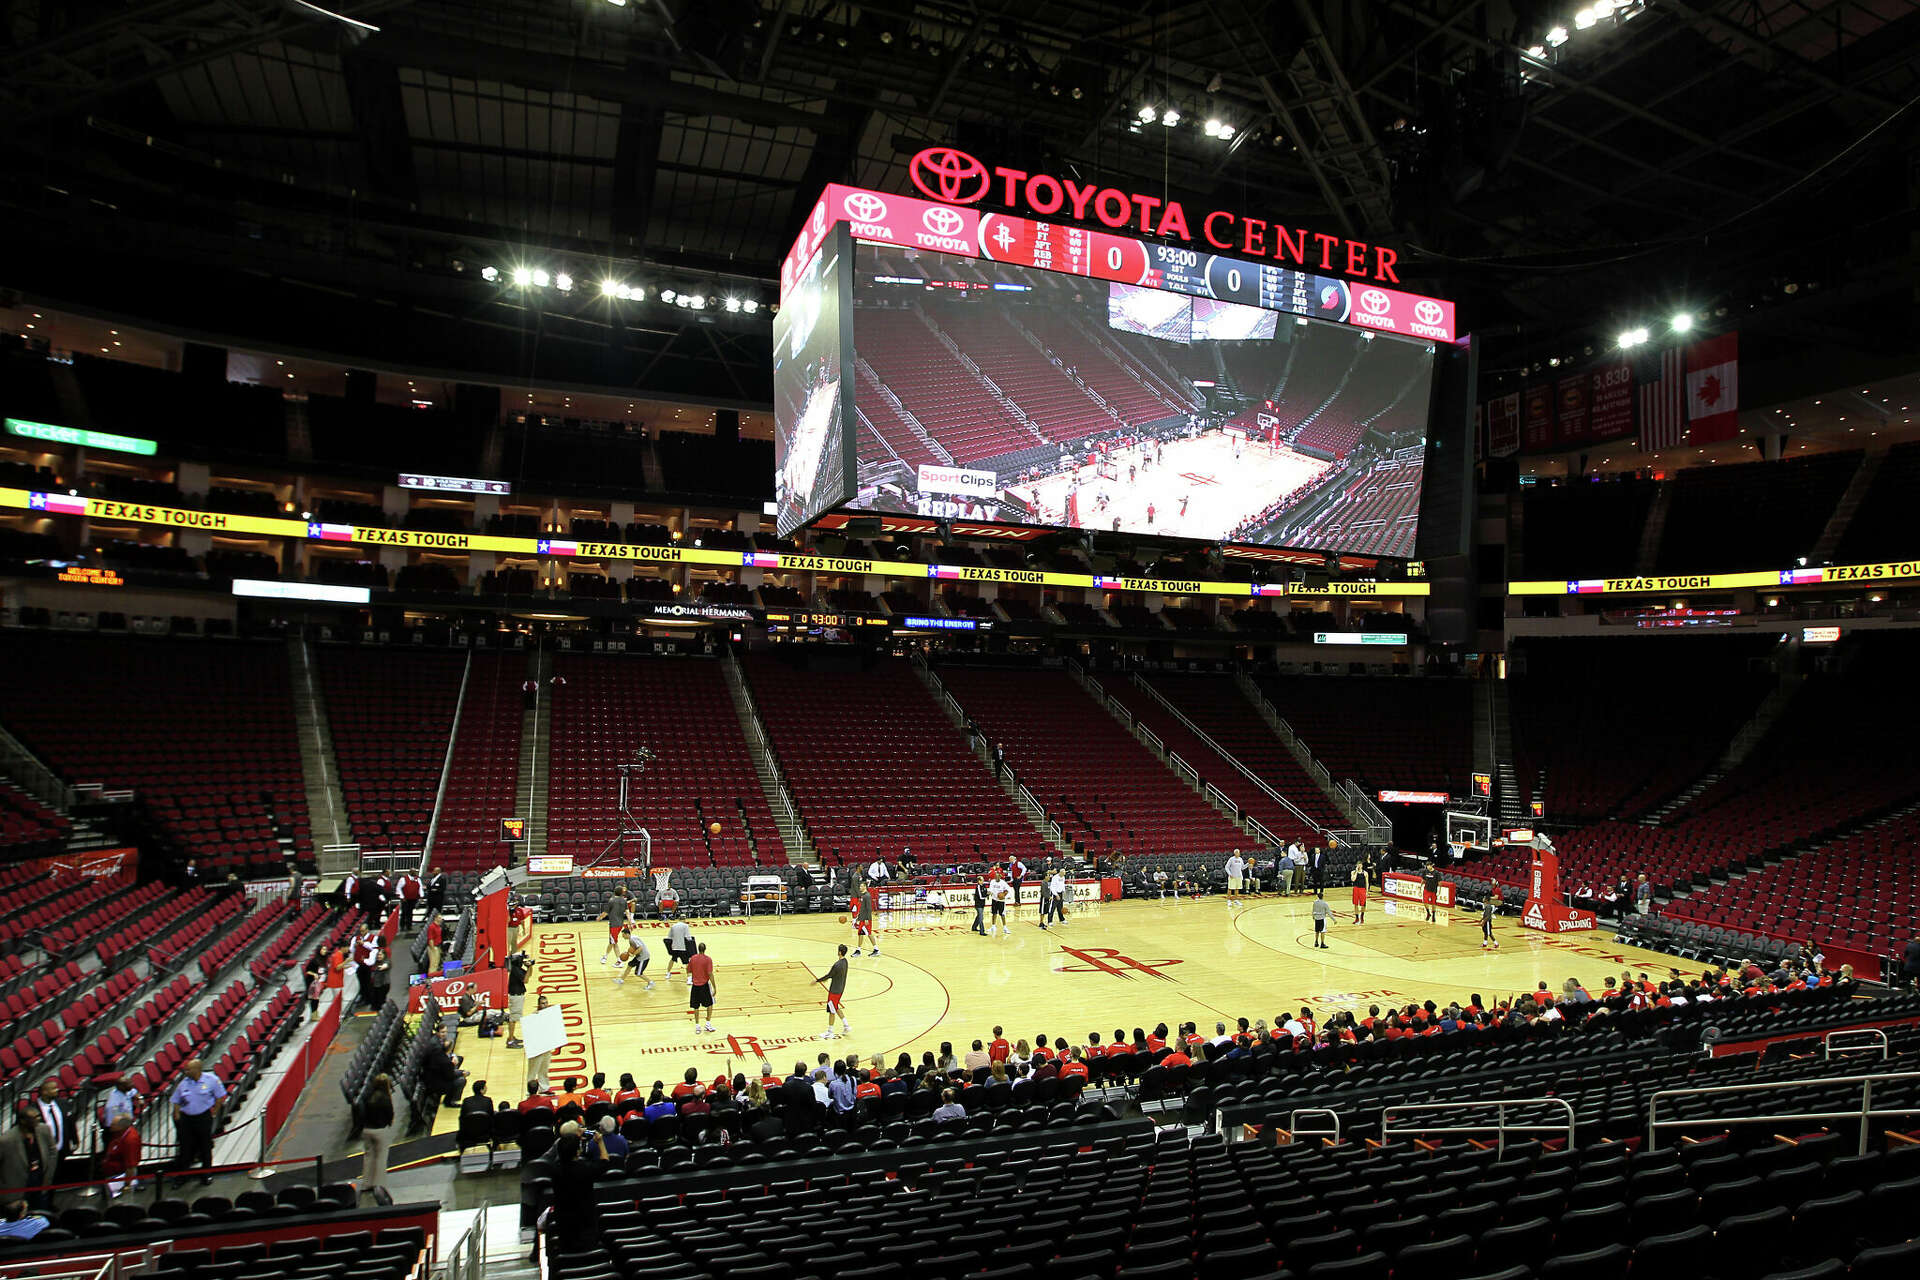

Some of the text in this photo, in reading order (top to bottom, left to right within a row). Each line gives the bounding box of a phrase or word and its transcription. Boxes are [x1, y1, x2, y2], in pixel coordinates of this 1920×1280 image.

[850, 221, 894, 240] OYOTA
[996, 166, 1400, 284] TOYOTA CENTER
[914, 232, 971, 253] TOYOTA
[1037, 231, 1049, 241] FT
[1033, 249, 1052, 259] REB
[1107, 246, 1122, 270] 0
[1157, 245, 1198, 268] 93:00
[1033, 258, 1053, 268] AST
[1227, 268, 1241, 292] 0
[1292, 304, 1309, 314] AST
[1355, 311, 1396, 329] TOYOTA
[1410, 322, 1449, 339] TOYOTA
[15, 422, 81, 443] cricket
[91, 501, 228, 528] TEXAS TOUGH
[917, 499, 1000, 522] REPLAY
[357, 528, 469, 548] TEXAS TOUGH
[580, 543, 682, 560] TEXAS TOUGH
[781, 556, 873, 572] TEXAS TOUGH
[962, 567, 1044, 583] TEXAS TOUGH
[1827, 565, 1884, 580] TEXAS
[1123, 578, 1201, 592] TEXAS TOUGH
[1334, 584, 1377, 594] TOUGH
[1608, 576, 1710, 591] TEXAS TOUGH
[654, 605, 748, 617] MEMORIAL HERMANN
[801, 614, 808, 623] 0
[811, 614, 838, 625] 93:00
[856, 616, 863, 626] 0
[905, 617, 929, 627] BRING
[930, 619, 944, 628] THE
[1523, 915, 1548, 930] PEAK
[1558, 917, 1593, 932] SPALDING
[530, 932, 582, 995] ROCKETS
[1292, 989, 1407, 1005] TOYOTA
[641, 1042, 725, 1055] HOUSTON
[762, 1032, 842, 1046] ROCKES
